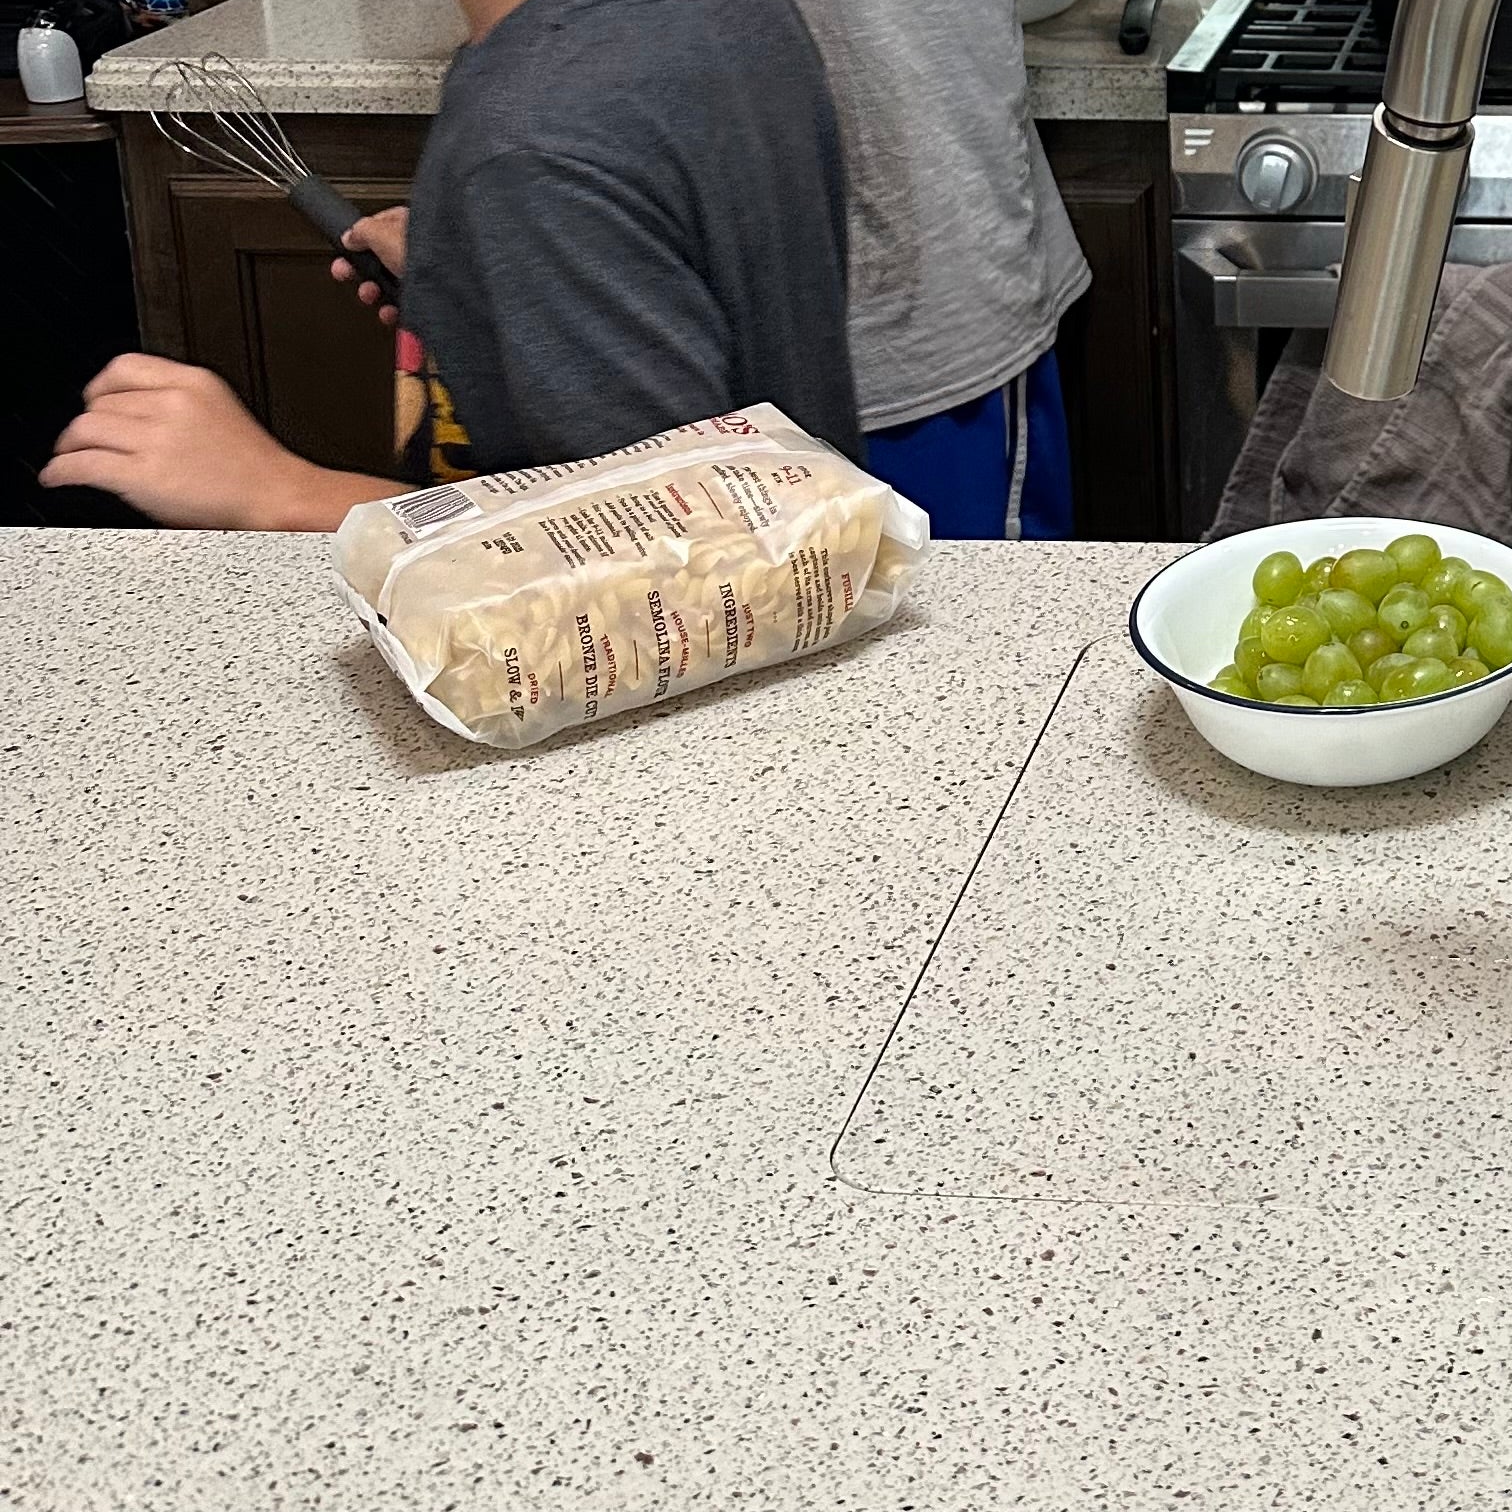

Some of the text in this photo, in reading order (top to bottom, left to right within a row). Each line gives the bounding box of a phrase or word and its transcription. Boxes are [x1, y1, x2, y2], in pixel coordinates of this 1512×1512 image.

[647, 590, 671, 666] SEMOLINA
[719, 582, 739, 668] INGREDIENTS
[742, 603, 755, 648] JUST TWO
[504, 647, 521, 685] SLOW
[527, 673, 539, 705] DRIED
[576, 613, 599, 720] BRONZE DIE CUT
[600, 633, 617, 699] TRADITIONAL
[509, 689, 522, 703] &
